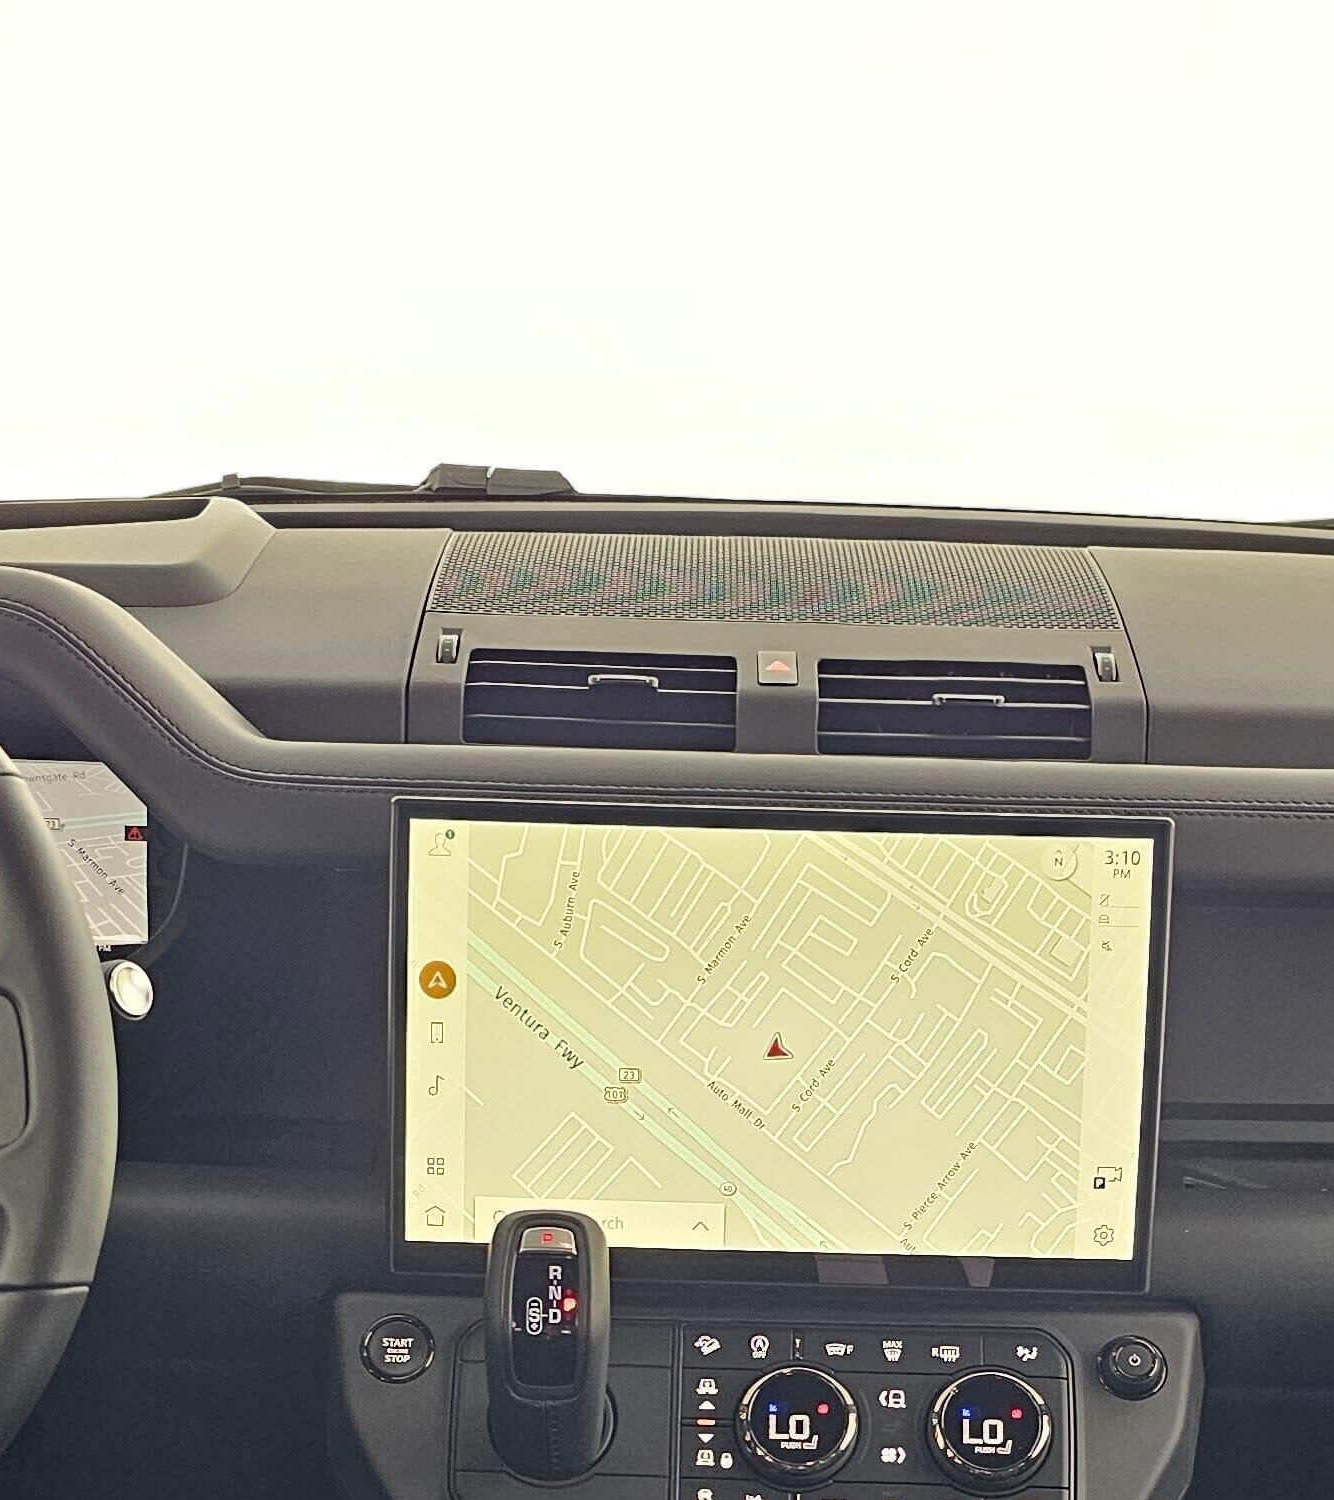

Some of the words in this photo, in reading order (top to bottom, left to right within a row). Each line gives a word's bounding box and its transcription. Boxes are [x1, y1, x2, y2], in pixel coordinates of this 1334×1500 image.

[1054, 857, 1064, 867] N
[1104, 850, 1142, 866] 3:10
[76, 848, 107, 880] Marmon
[109, 880, 124, 896] Ave
[1113, 869, 1131, 879] PM
[554, 939, 564, 950] S
[560, 897, 576, 937] Auburn
[569, 871, 581, 891] Ave
[697, 975, 707, 986] S
[705, 934, 737, 975] Marmon
[735, 913, 752, 934] Ave
[890, 974, 901, 984] S
[899, 948, 919, 974] Cord
[917, 928, 934, 948] Ave
[495, 985, 551, 1041] Ventura
[554, 1039, 584, 1070] Fwy
[622, 1071, 635, 1080] 23
[791, 1103, 801, 1113] S
[799, 1078, 820, 1103] Cord
[818, 1058, 835, 1078] Ave
[707, 1081, 729, 1102] Auto
[731, 1099, 753, 1121] Mall
[753, 1117, 767, 1130] Dr
[903, 1221, 913, 1231] S
[911, 1191, 938, 1220] Pierce
[937, 1162, 961, 1191] Arrow
[959, 1141, 977, 1161] Ave
[602, 1216, 624, 1230] rch
[542, 1233, 555, 1245] P
[548, 1265, 563, 1280] R
[548, 1285, 562, 1301] N
[528, 1307, 541, 1323] S
[548, 1308, 562, 1324] D
[382, 1338, 414, 1348] START
[882, 1340, 903, 1349] MAX
[384, 1354, 411, 1363] STOP
[768, 1414, 810, 1440] LO
[962, 1418, 1004, 1445] LO
